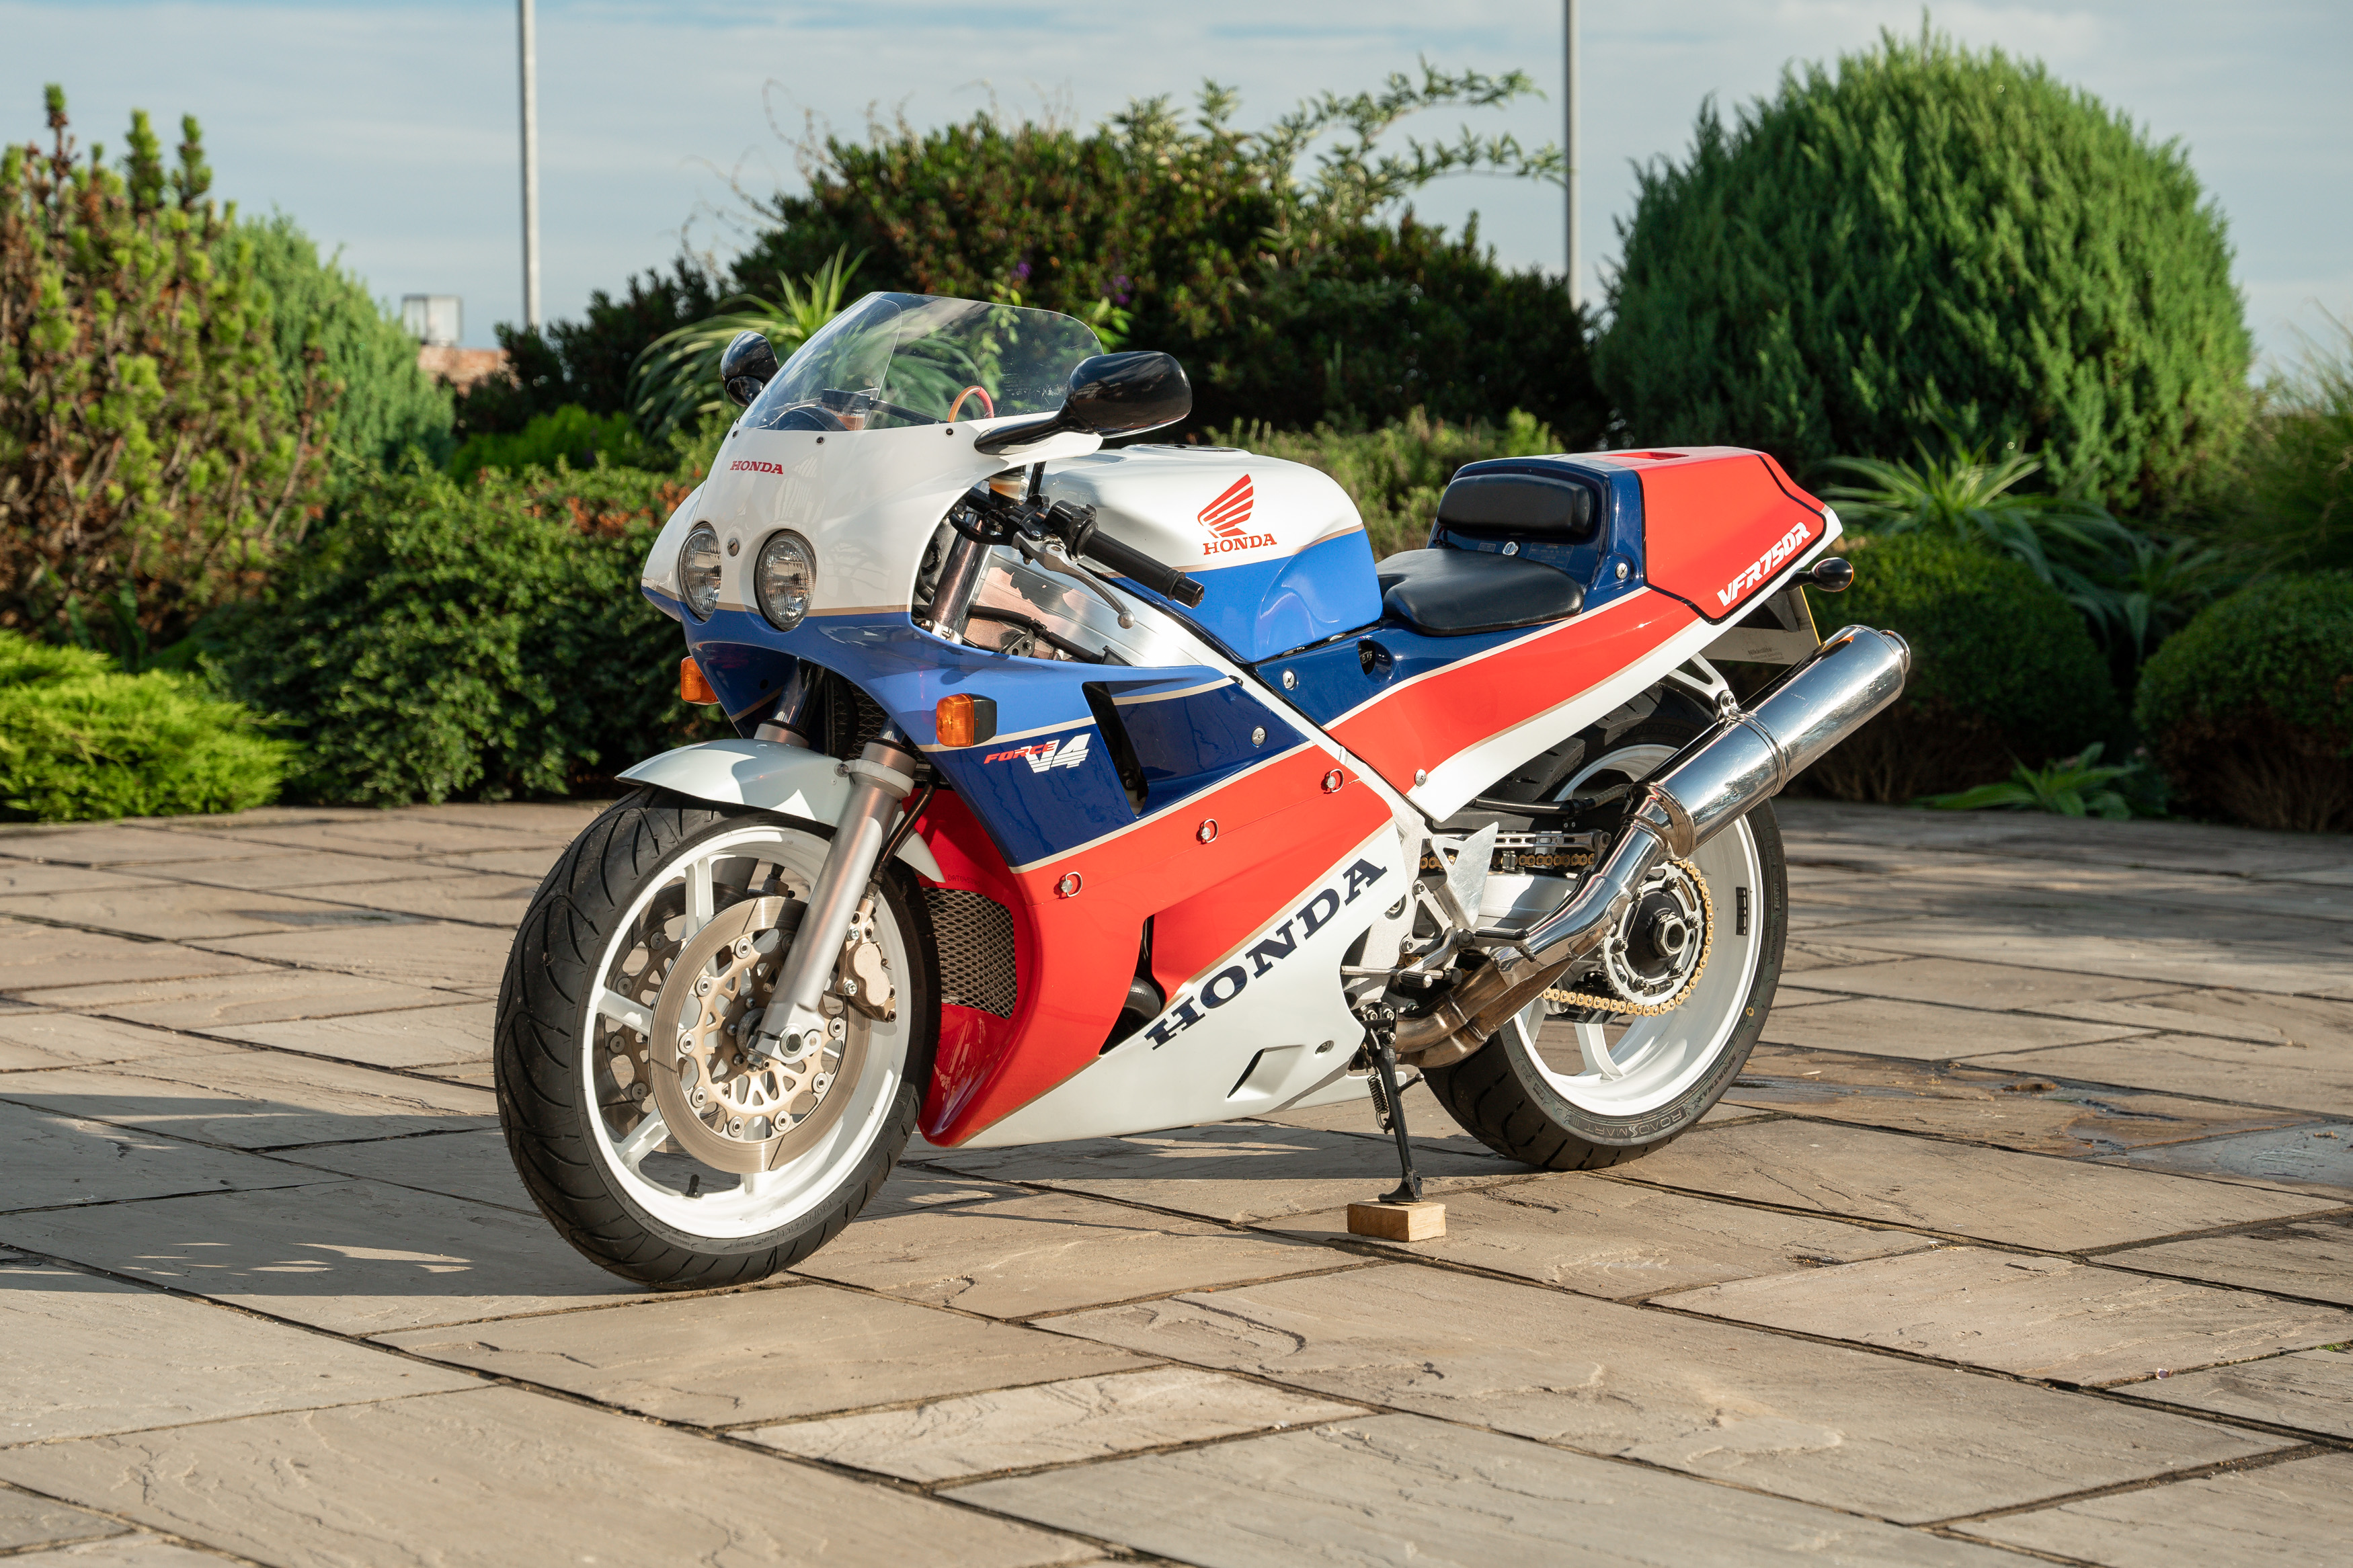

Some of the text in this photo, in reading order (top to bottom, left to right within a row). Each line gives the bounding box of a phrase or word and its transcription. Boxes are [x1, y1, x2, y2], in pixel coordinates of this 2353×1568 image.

[729, 460, 783, 474] HONDA
[1203, 534, 1277, 555] HONDA
[1717, 522, 1811, 606] VFR750R
[984, 733, 1091, 774] FORCE V4
[1144, 858, 1388, 1050] HONDA
[1696, 1054, 1737, 1102] SPORTMAX
